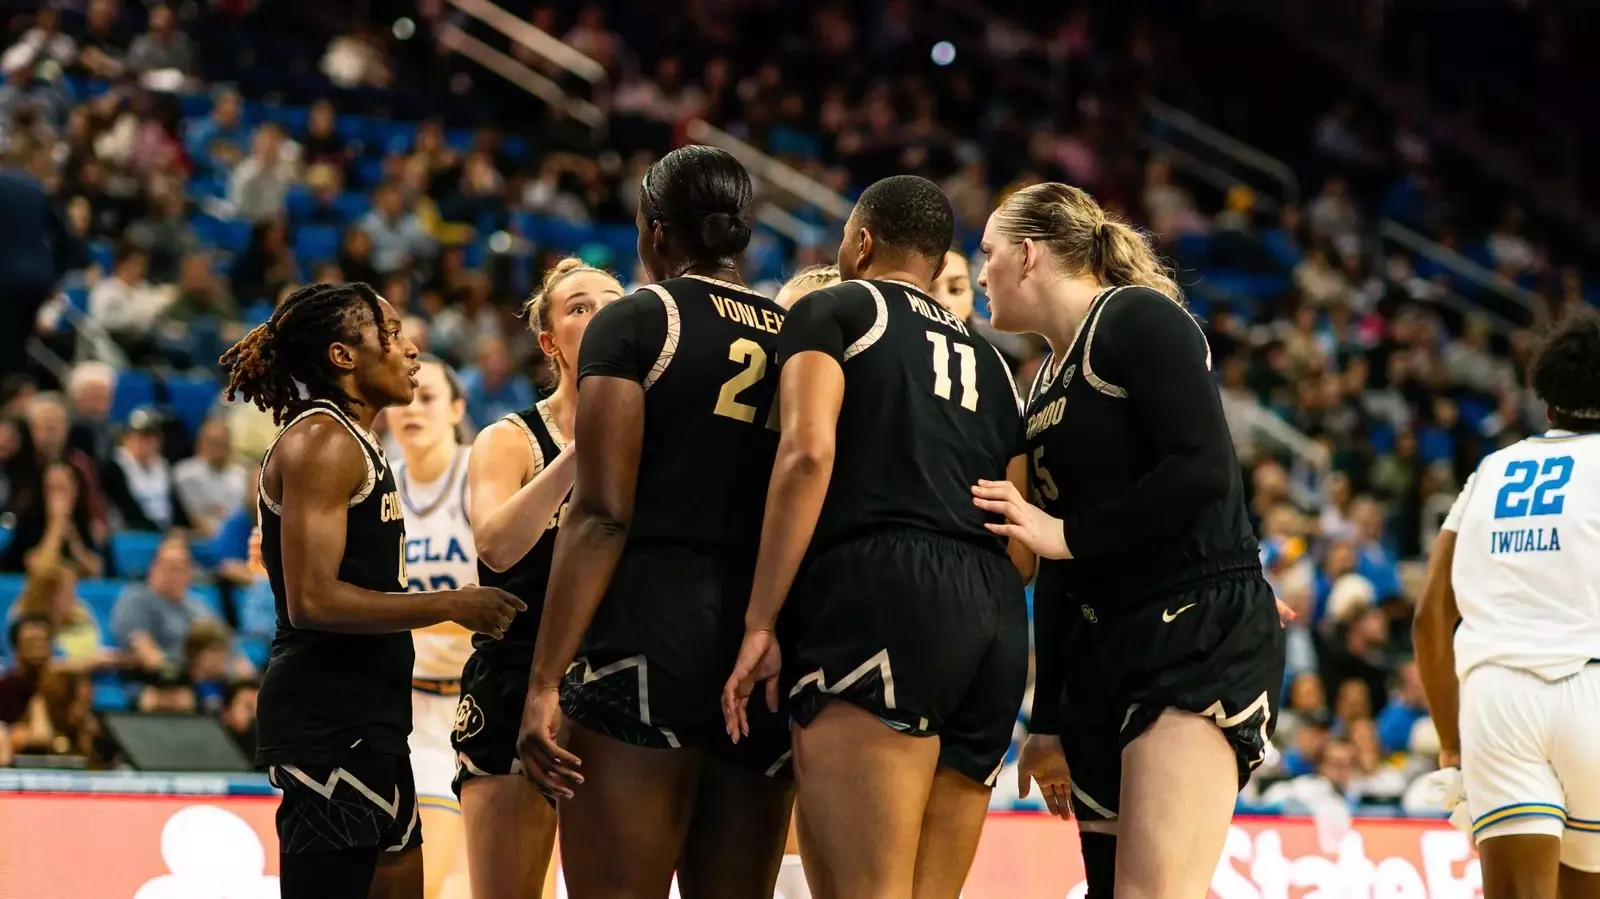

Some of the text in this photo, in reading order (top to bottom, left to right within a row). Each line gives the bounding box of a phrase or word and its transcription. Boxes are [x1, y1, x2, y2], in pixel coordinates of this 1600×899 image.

[903, 290, 971, 338] MILLER
[713, 337, 780, 431] 2
[926, 330, 979, 413] 11
[1032, 444, 1059, 507] 5
[1494, 455, 1575, 519] 22
[405, 536, 469, 564] CLA
[1491, 527, 1561, 554] IWUALA
